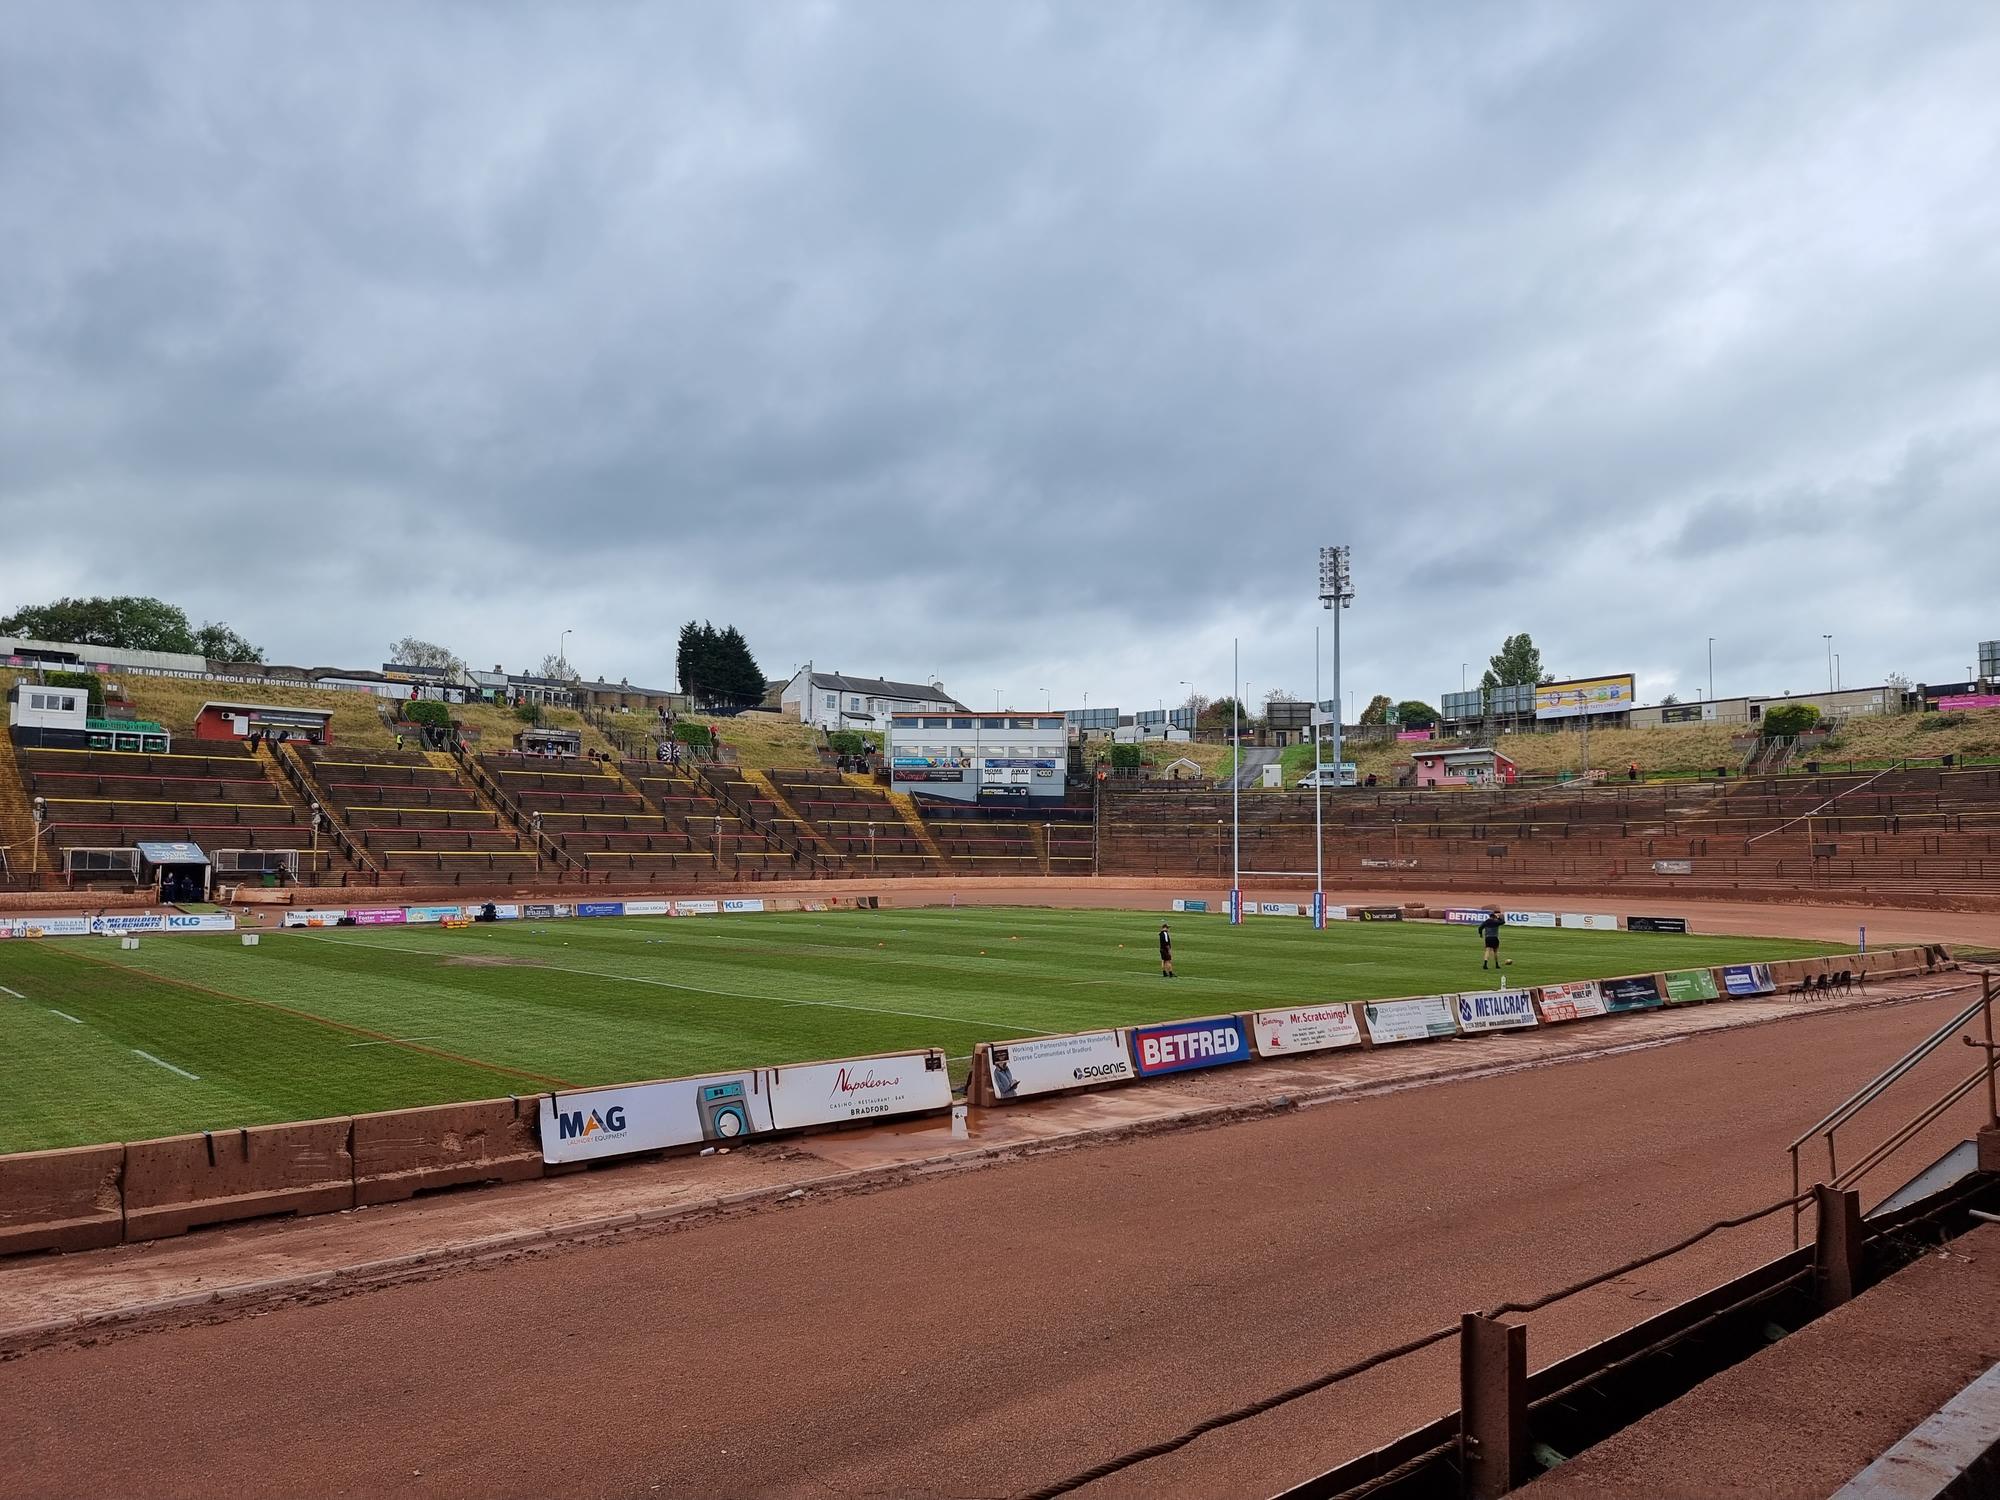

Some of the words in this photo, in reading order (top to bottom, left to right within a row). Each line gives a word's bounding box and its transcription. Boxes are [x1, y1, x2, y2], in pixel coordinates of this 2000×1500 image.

[127, 667, 143, 675] THE
[145, 669, 160, 677] IAN
[163, 671, 202, 680] PATCHETT
[216, 675, 244, 684] NICOLA
[246, 677, 262, 685] KAY
[263, 679, 308, 689] MORTGAGES
[725, 901, 744, 909] KLG
[1263, 904, 1280, 912] KLG
[169, 916, 201, 927] KLG
[1448, 912, 1491, 921] BETFRED
[1507, 913, 1529, 922] KLG
[13, 927, 26, 938] 40
[1475, 994, 1530, 1018] METALCRAFT
[1261, 1017, 1284, 1027] Scratchings
[1290, 1014, 1303, 1024] Mr.
[1304, 1009, 1347, 1024] Scratchings
[1012, 1043, 1034, 1053] Working
[1039, 1040, 1067, 1050] Partnership
[1087, 1035, 1113, 1043] Wonderfully
[1143, 1027, 1240, 1065] BETFRED
[1013, 1054, 1032, 1062] Diverse
[1033, 1050, 1066, 1060] Communities
[1072, 1046, 1092, 1054] Bradford
[829, 1065, 900, 1100] Napoleons
[830, 1101, 852, 1109] CASINO
[858, 1096, 890, 1105] RESTAURANT
[850, 1104, 889, 1116] BRADFORD
[560, 1106, 626, 1139] MAG
[567, 1137, 593, 1146] LAUNDRY
[594, 1131, 628, 1142] EQUIPMENT
